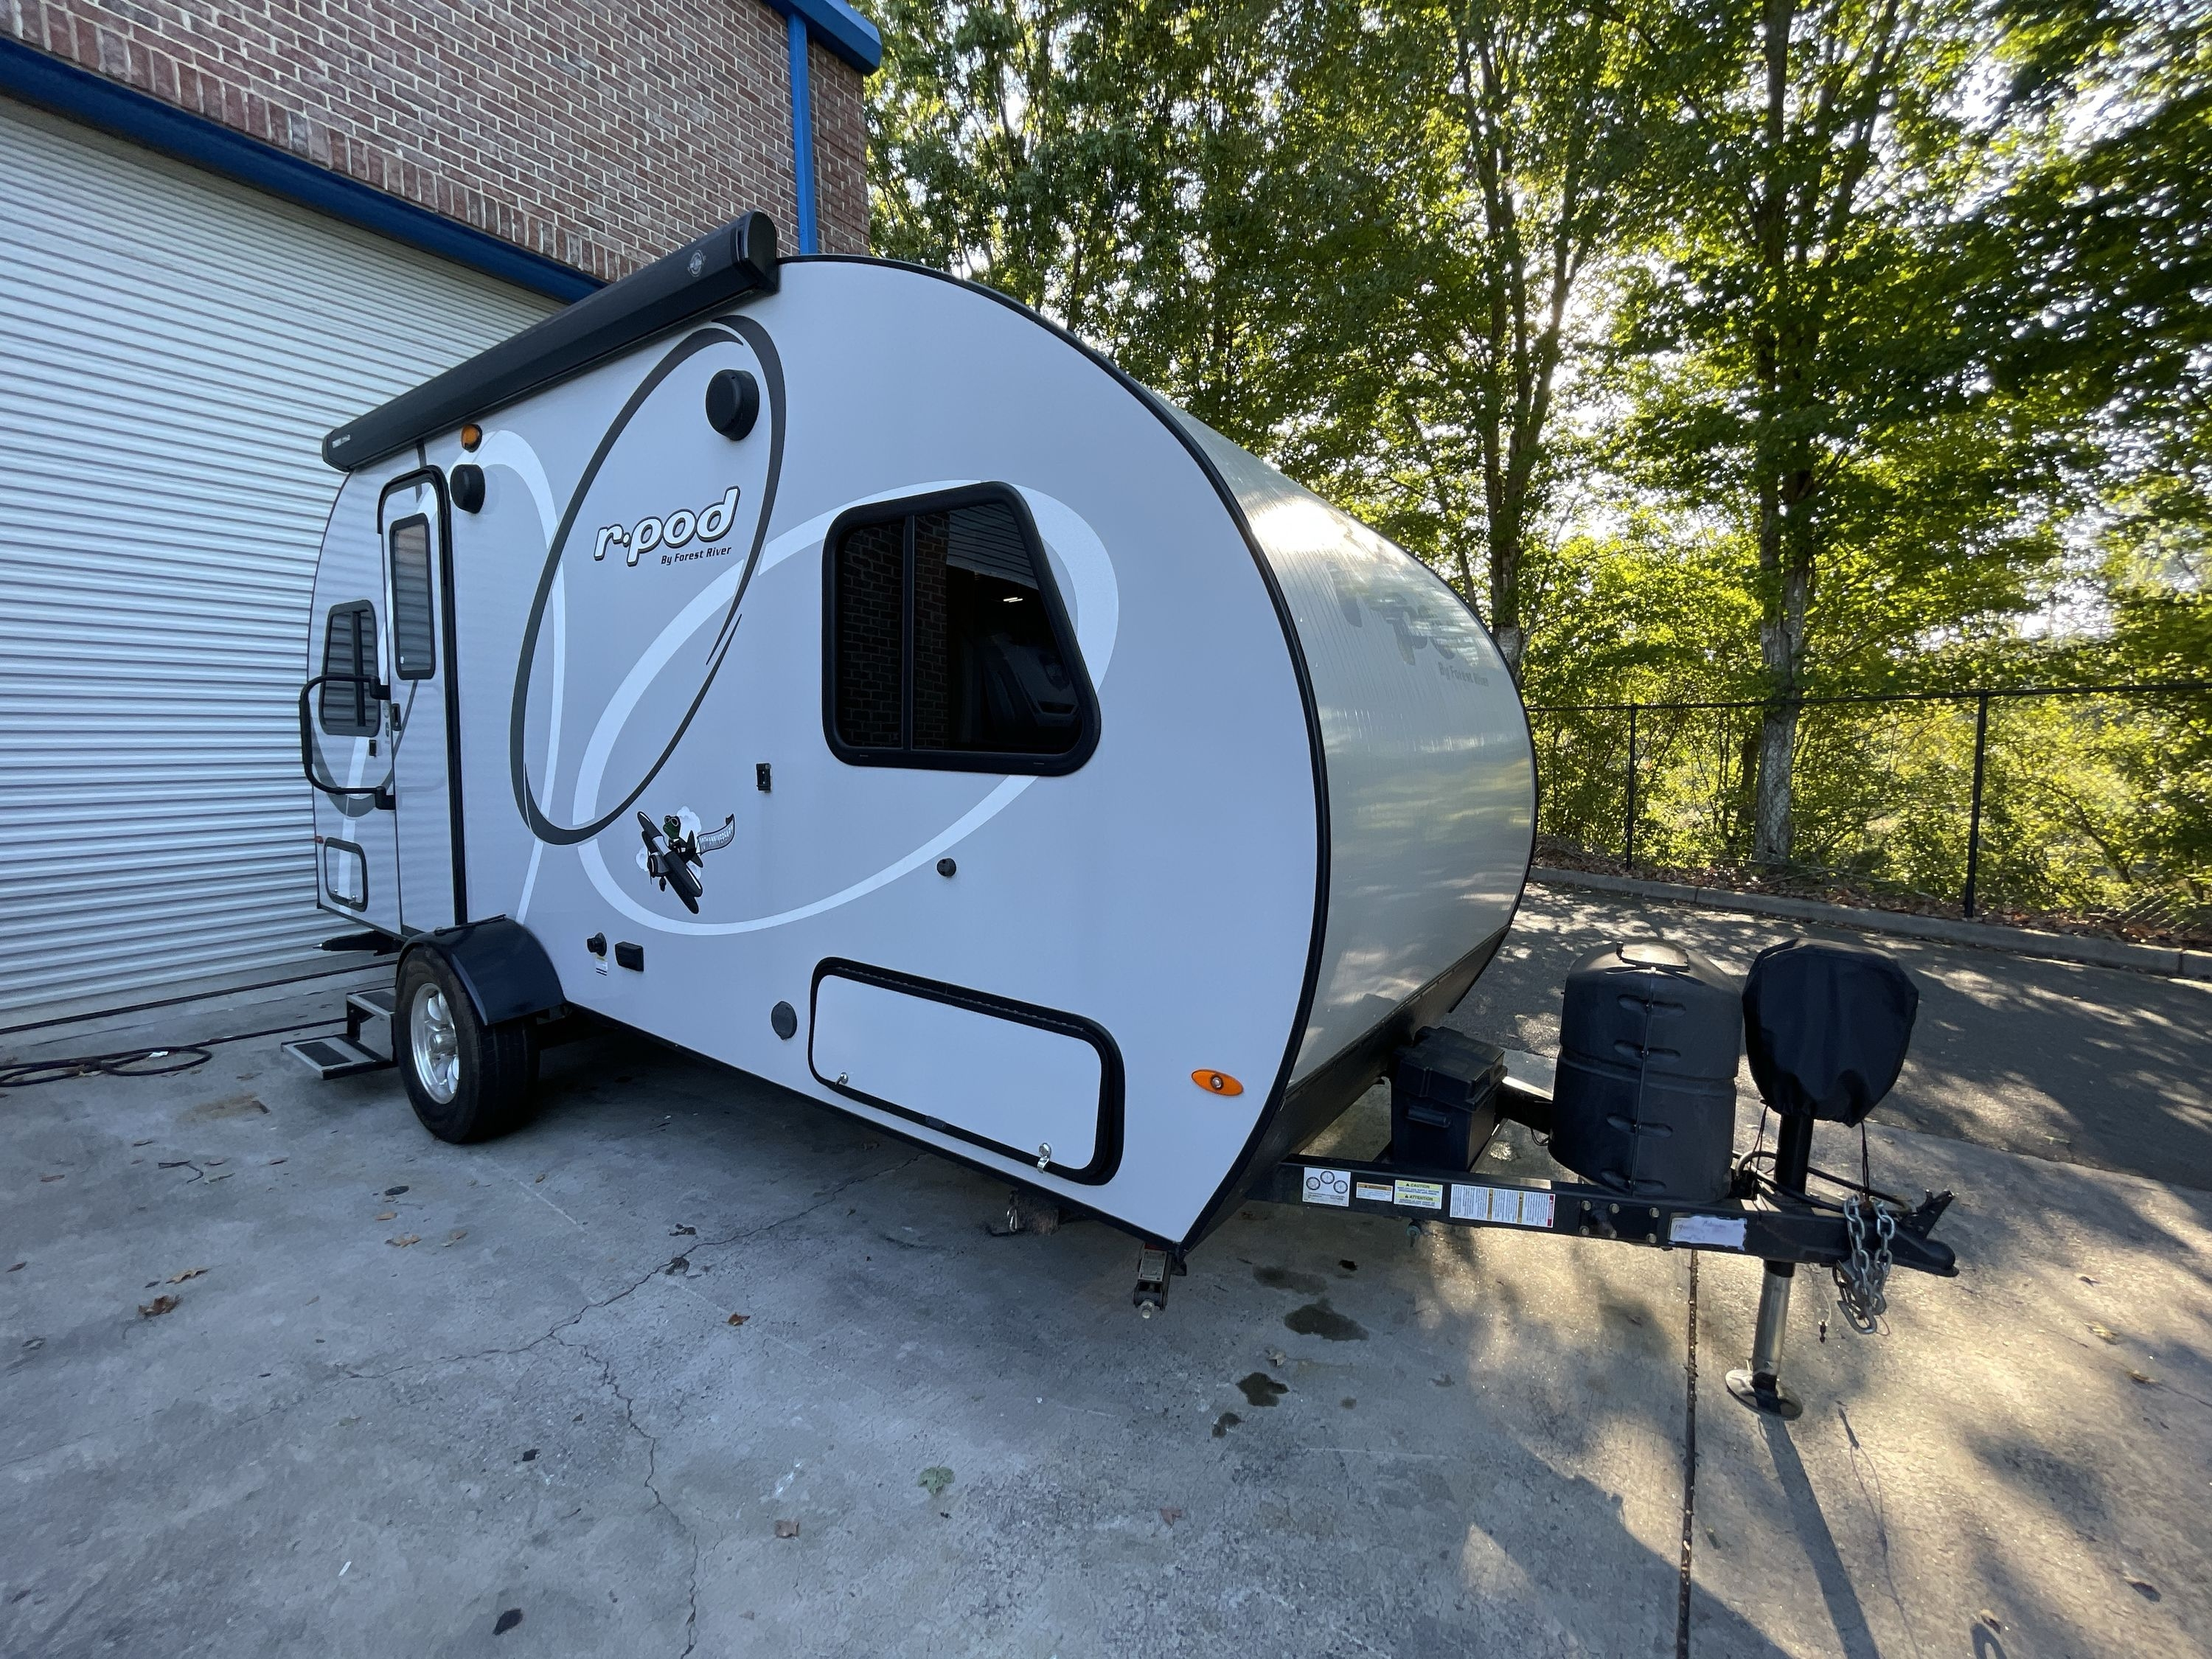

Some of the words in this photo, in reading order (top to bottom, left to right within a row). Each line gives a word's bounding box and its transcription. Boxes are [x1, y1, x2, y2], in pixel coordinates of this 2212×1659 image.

[661, 554, 672, 566] By
[674, 551, 703, 563] Forest
[706, 546, 732, 557] River
